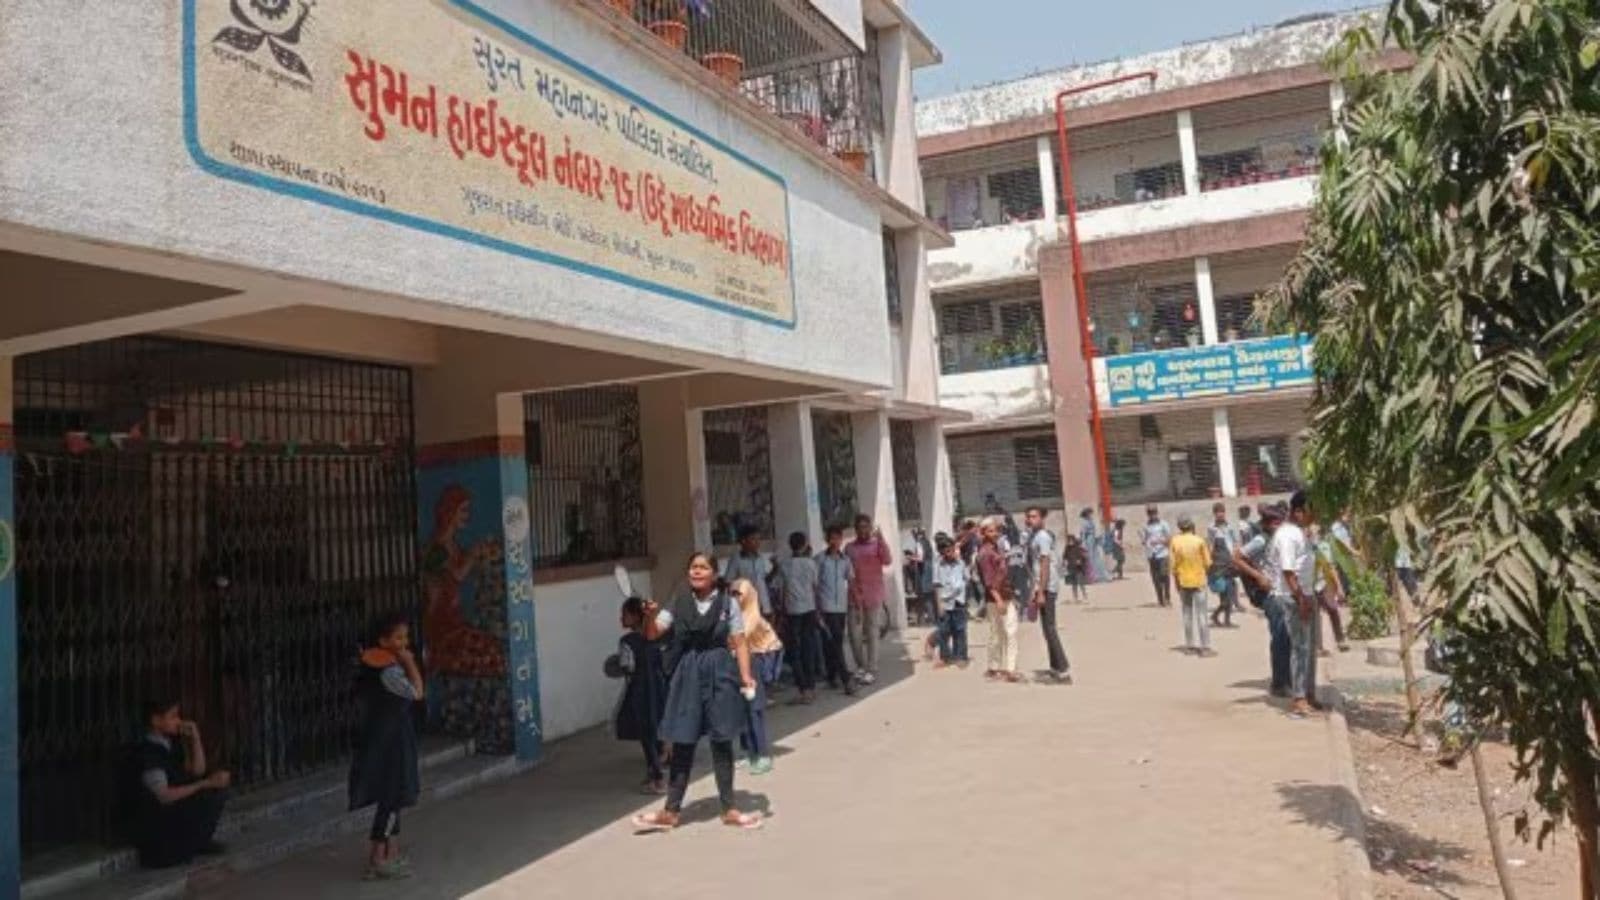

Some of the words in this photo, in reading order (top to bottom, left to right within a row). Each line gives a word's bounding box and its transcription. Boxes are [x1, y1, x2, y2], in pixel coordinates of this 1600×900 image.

[344, 49, 438, 142] સુમન
[670, 192, 738, 253] માધ્યમિક
[473, 36, 525, 92] સુરત
[534, 67, 610, 132] મહાનગર
[615, 104, 666, 159] પાલિકા
